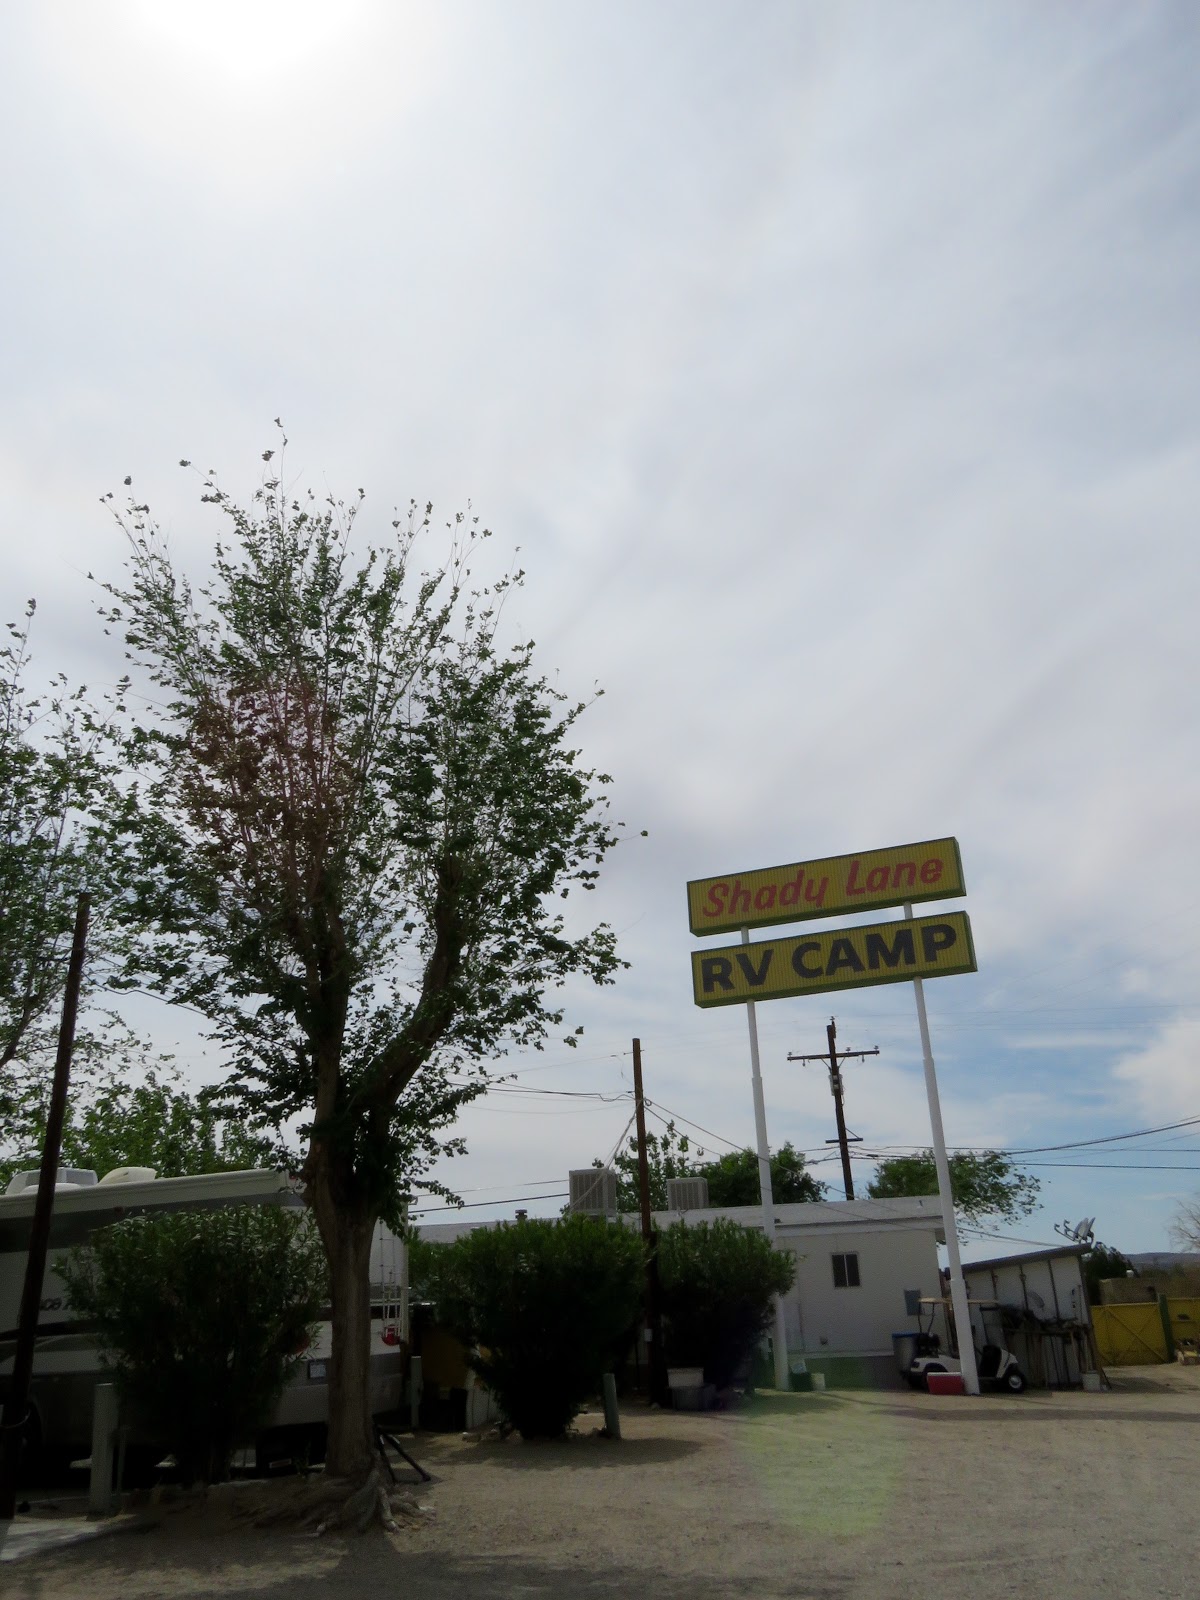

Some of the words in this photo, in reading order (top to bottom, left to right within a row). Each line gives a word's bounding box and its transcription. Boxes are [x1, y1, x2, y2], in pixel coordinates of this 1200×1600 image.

[703, 869, 829, 917] Shady
[845, 858, 944, 896] Lane
[701, 949, 774, 993] RV
[791, 923, 957, 979] CAMP
